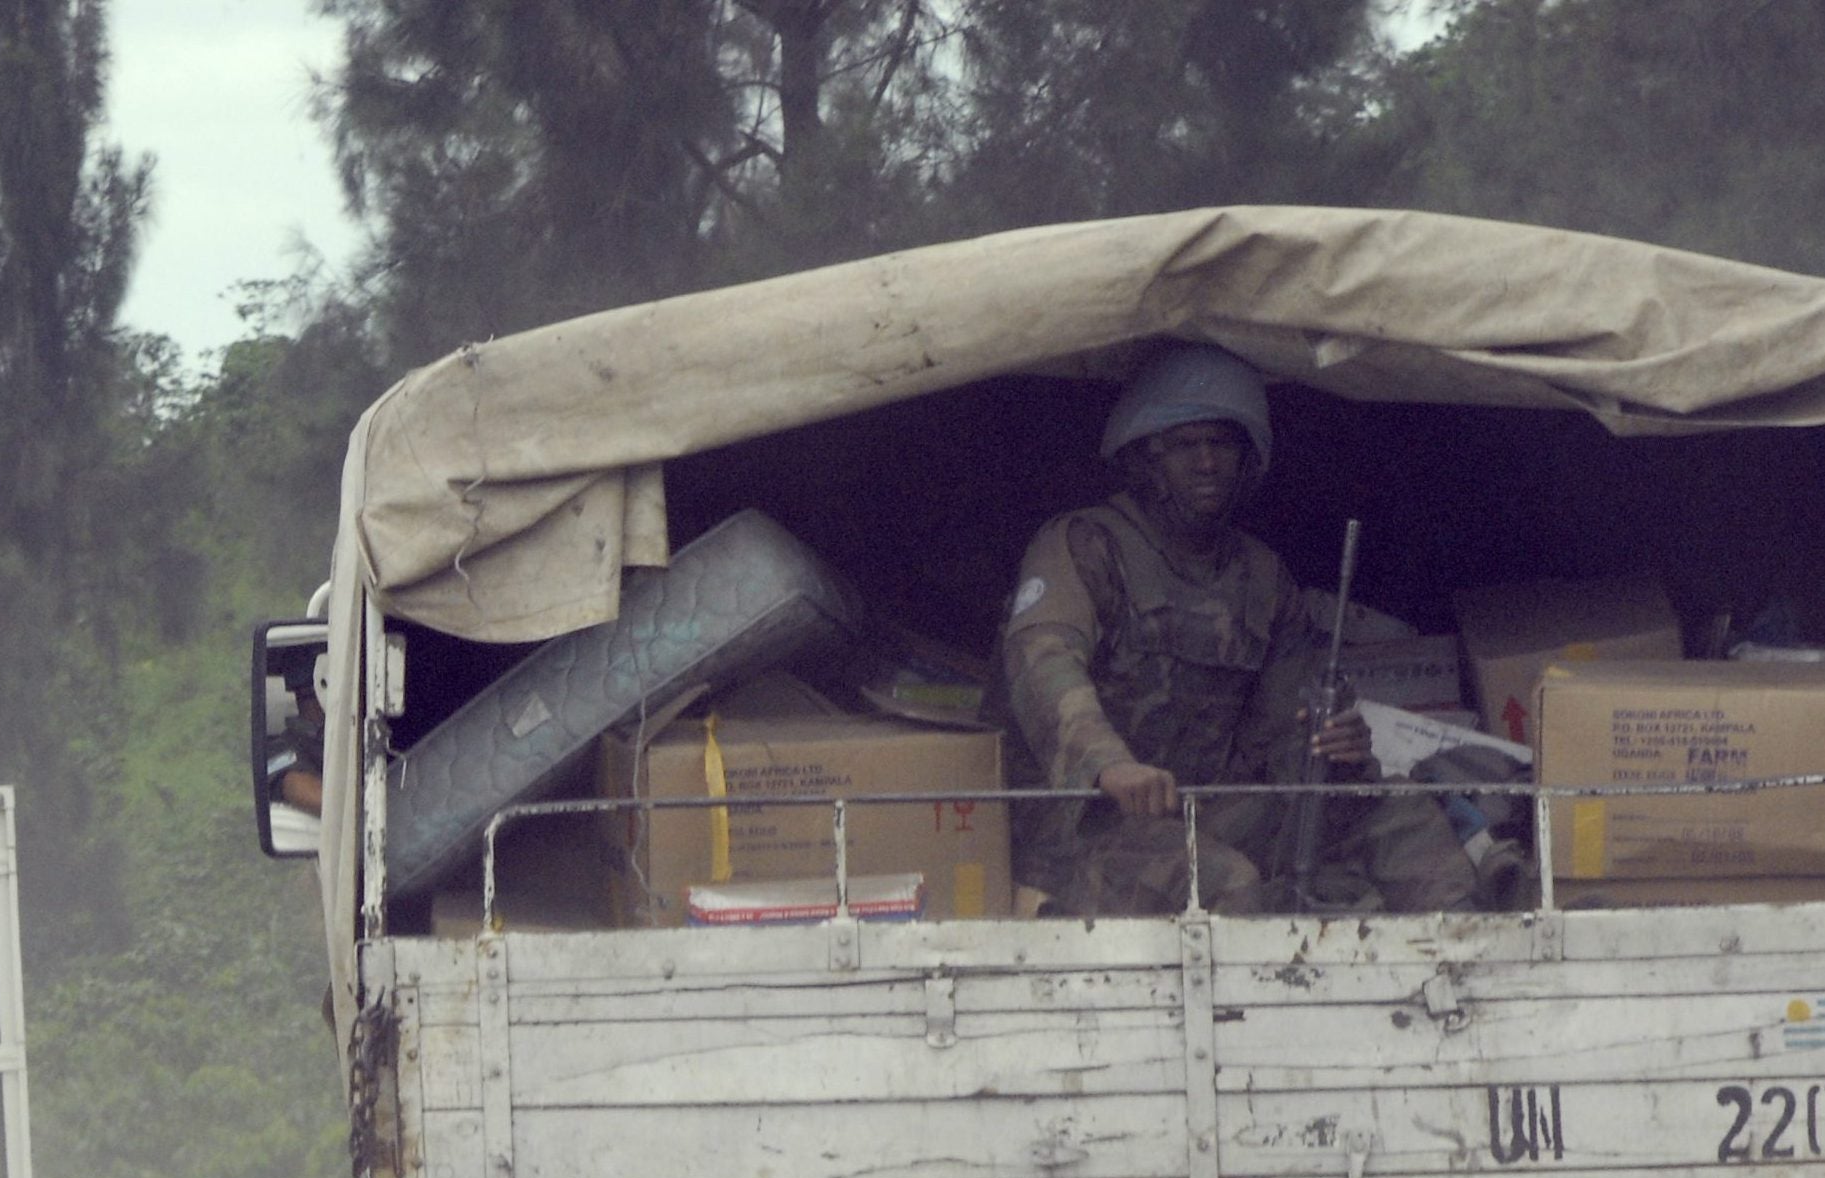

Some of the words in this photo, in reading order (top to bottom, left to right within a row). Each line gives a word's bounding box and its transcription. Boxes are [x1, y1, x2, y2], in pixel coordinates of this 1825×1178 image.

[1659, 709, 1701, 719] AFRICA
[1636, 722, 1661, 733] BOX
[1488, 1084, 1564, 1164] UN
